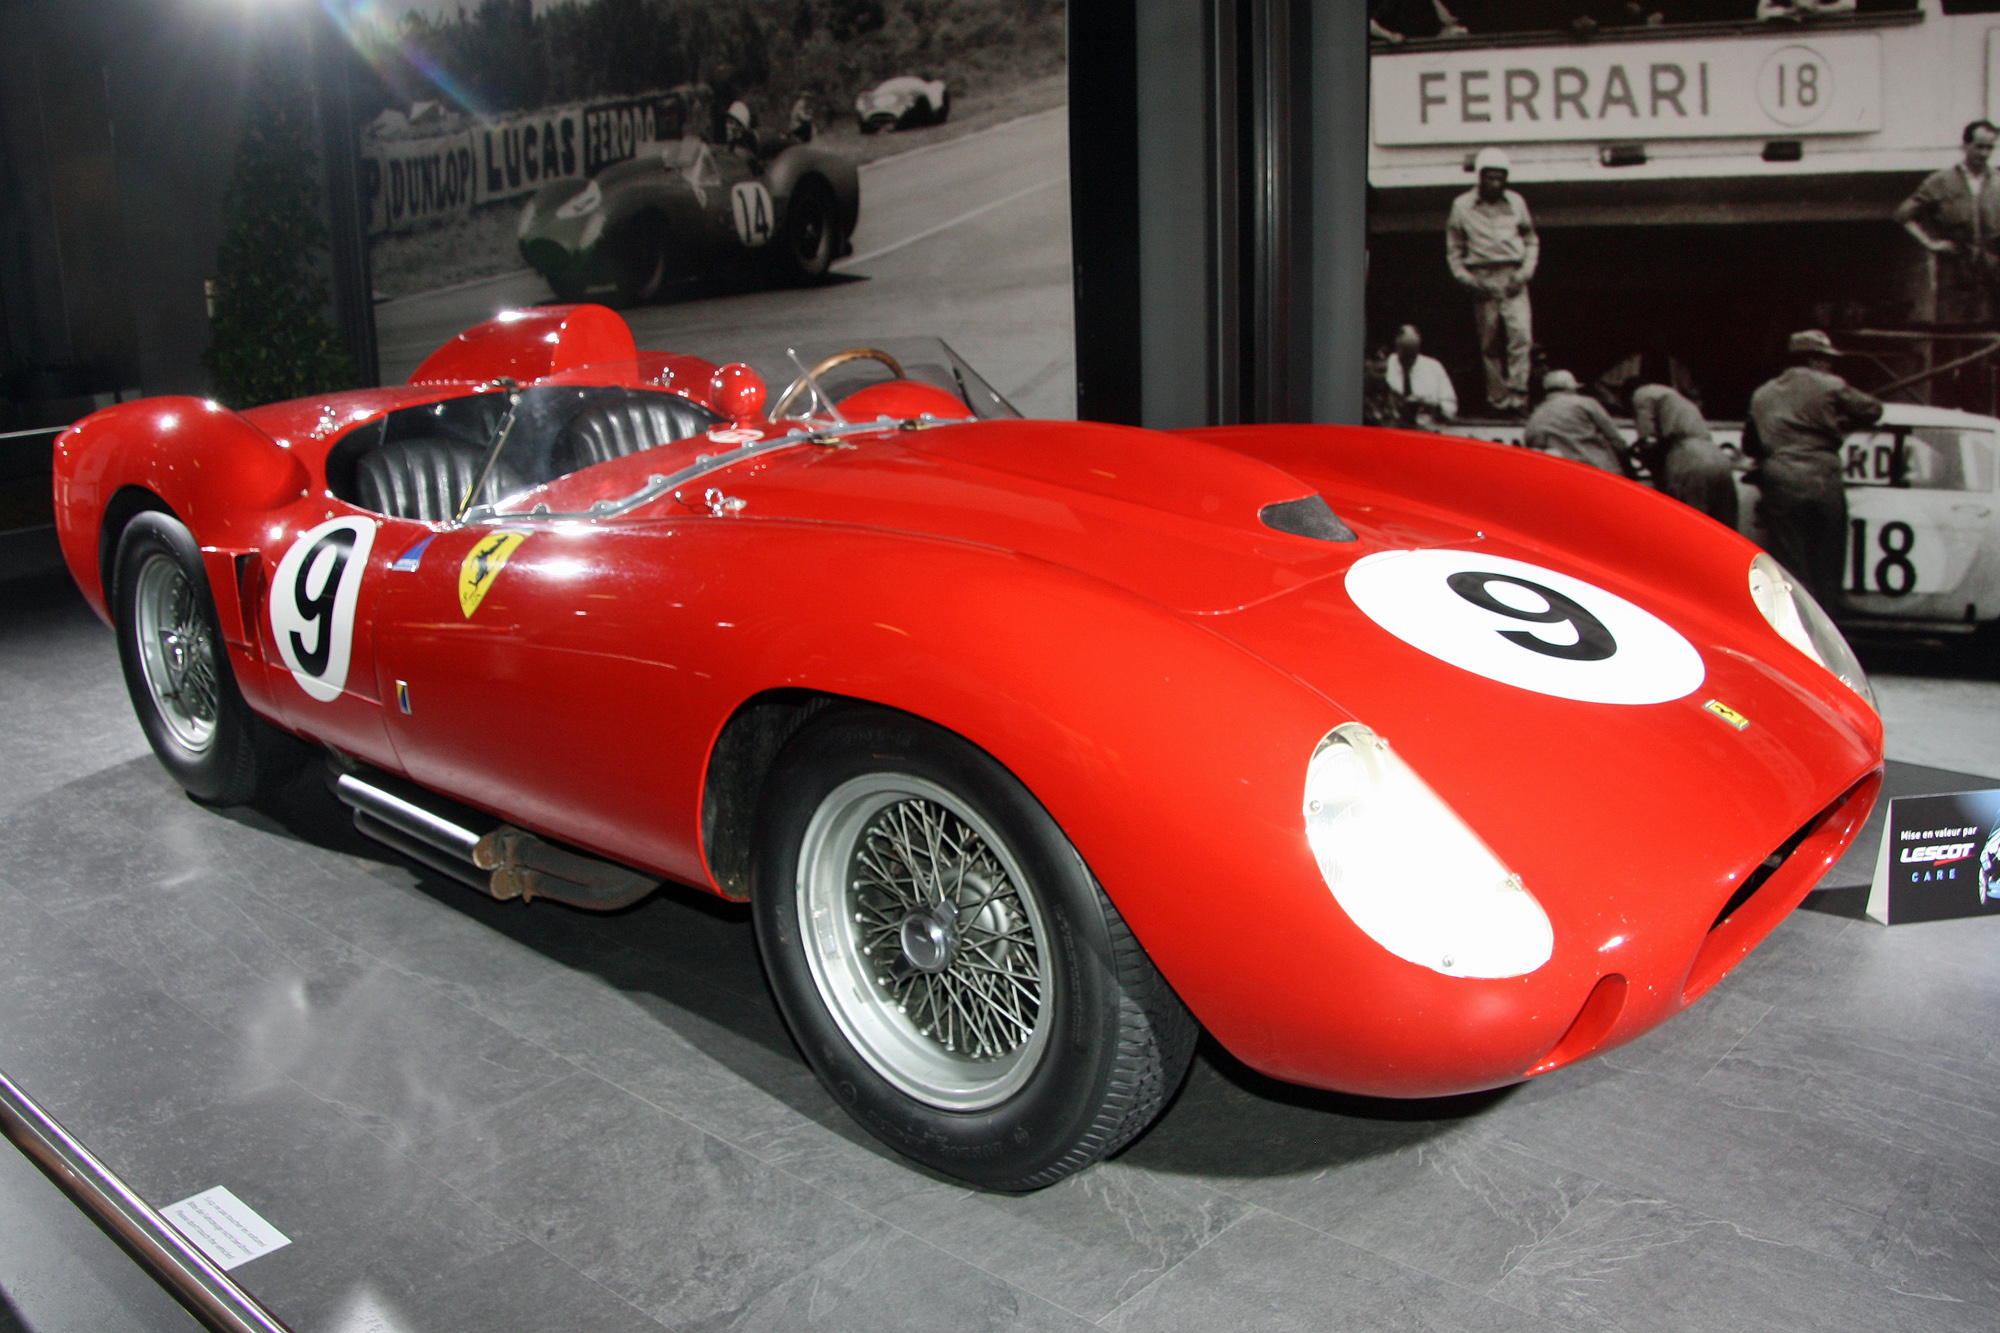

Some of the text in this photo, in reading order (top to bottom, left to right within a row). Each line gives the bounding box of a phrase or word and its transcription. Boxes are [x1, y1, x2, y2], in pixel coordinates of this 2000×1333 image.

[1419, 61, 1818, 124] FERRARI 18
[388, 146, 470, 218] DUNLOP
[484, 116, 575, 192] LUCAS
[736, 186, 768, 243] 14
[1851, 518, 1917, 597] 18
[289, 527, 357, 678] 9
[1446, 571, 1618, 661] 9
[1900, 827, 1978, 841] Mise en valeur par
[1900, 843, 1976, 863] LESCOT
[1911, 868, 1957, 883] CARE
